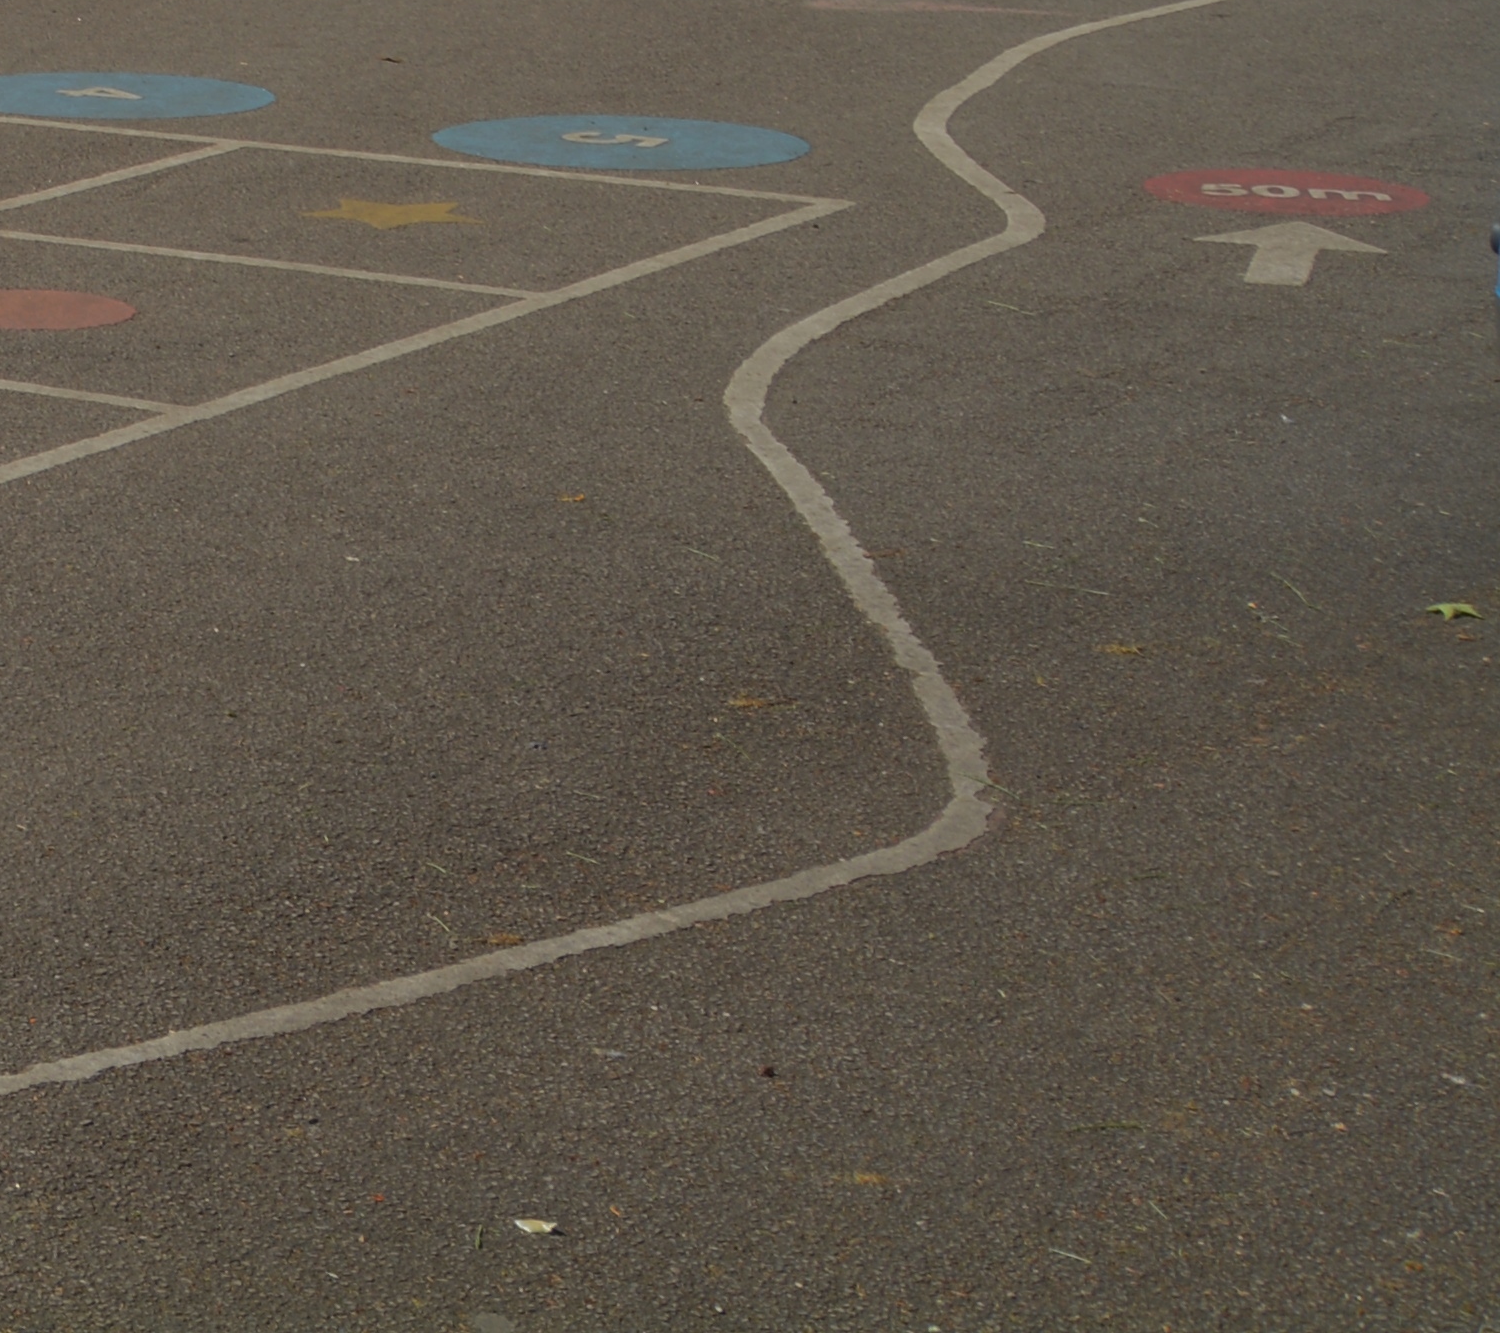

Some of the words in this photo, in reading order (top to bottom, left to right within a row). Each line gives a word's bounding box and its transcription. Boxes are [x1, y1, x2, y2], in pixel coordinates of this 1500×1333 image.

[54, 86, 144, 101] 4
[560, 131, 670, 148] 5
[1200, 183, 1393, 202] 50m
